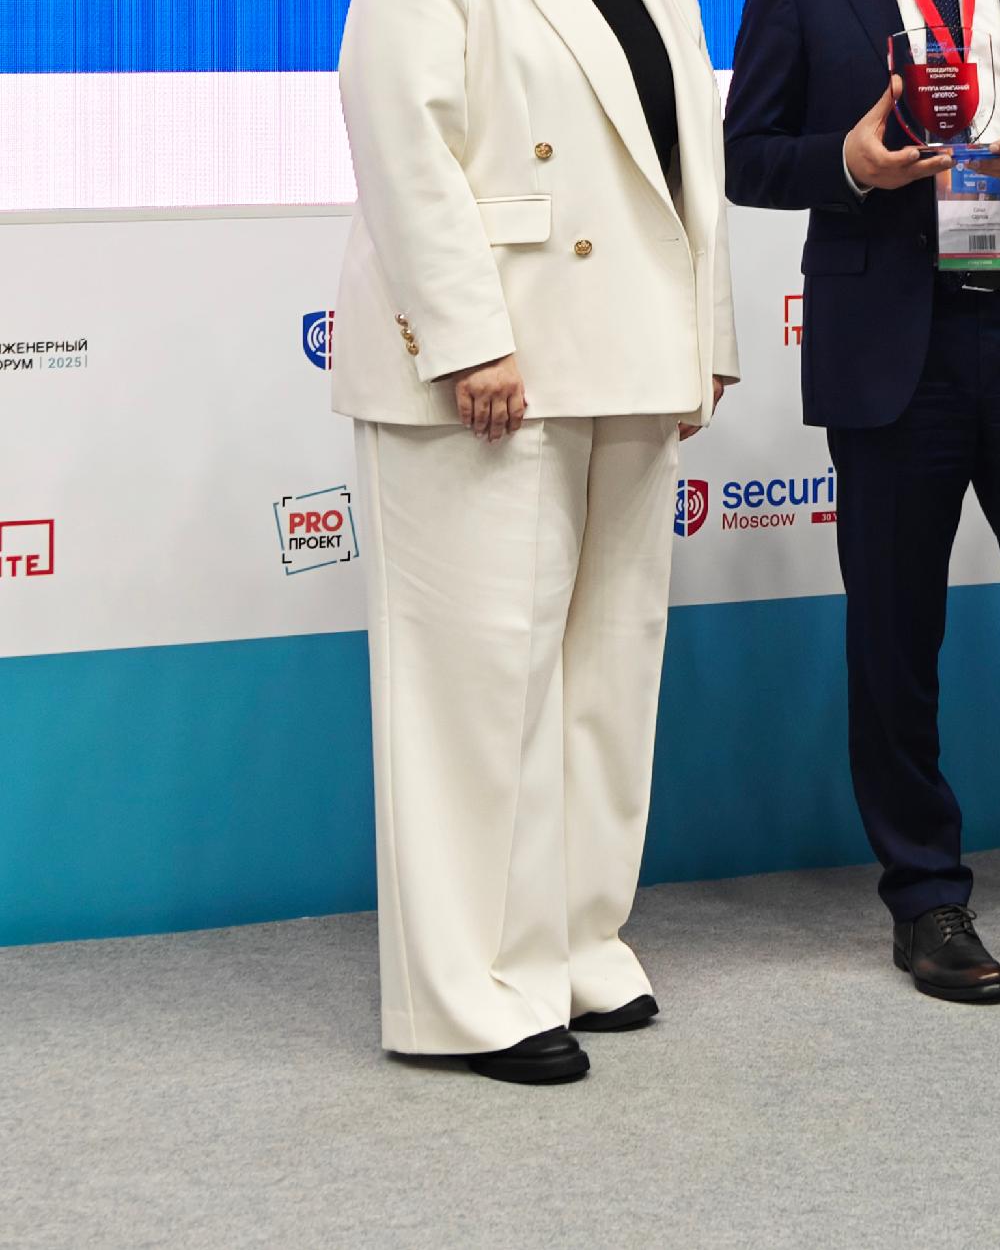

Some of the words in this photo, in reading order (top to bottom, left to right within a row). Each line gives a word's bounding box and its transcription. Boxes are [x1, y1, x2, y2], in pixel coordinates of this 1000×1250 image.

[784, 326, 803, 346] IT
[0, 338, 88, 354] ЖЕНЕРНЫЙ
[48, 356, 81, 369] 2025
[722, 466, 834, 510] securi
[289, 510, 344, 535] PRO
[722, 512, 796, 531] Moscow
[289, 535, 342, 551] ПРОЕКТ
